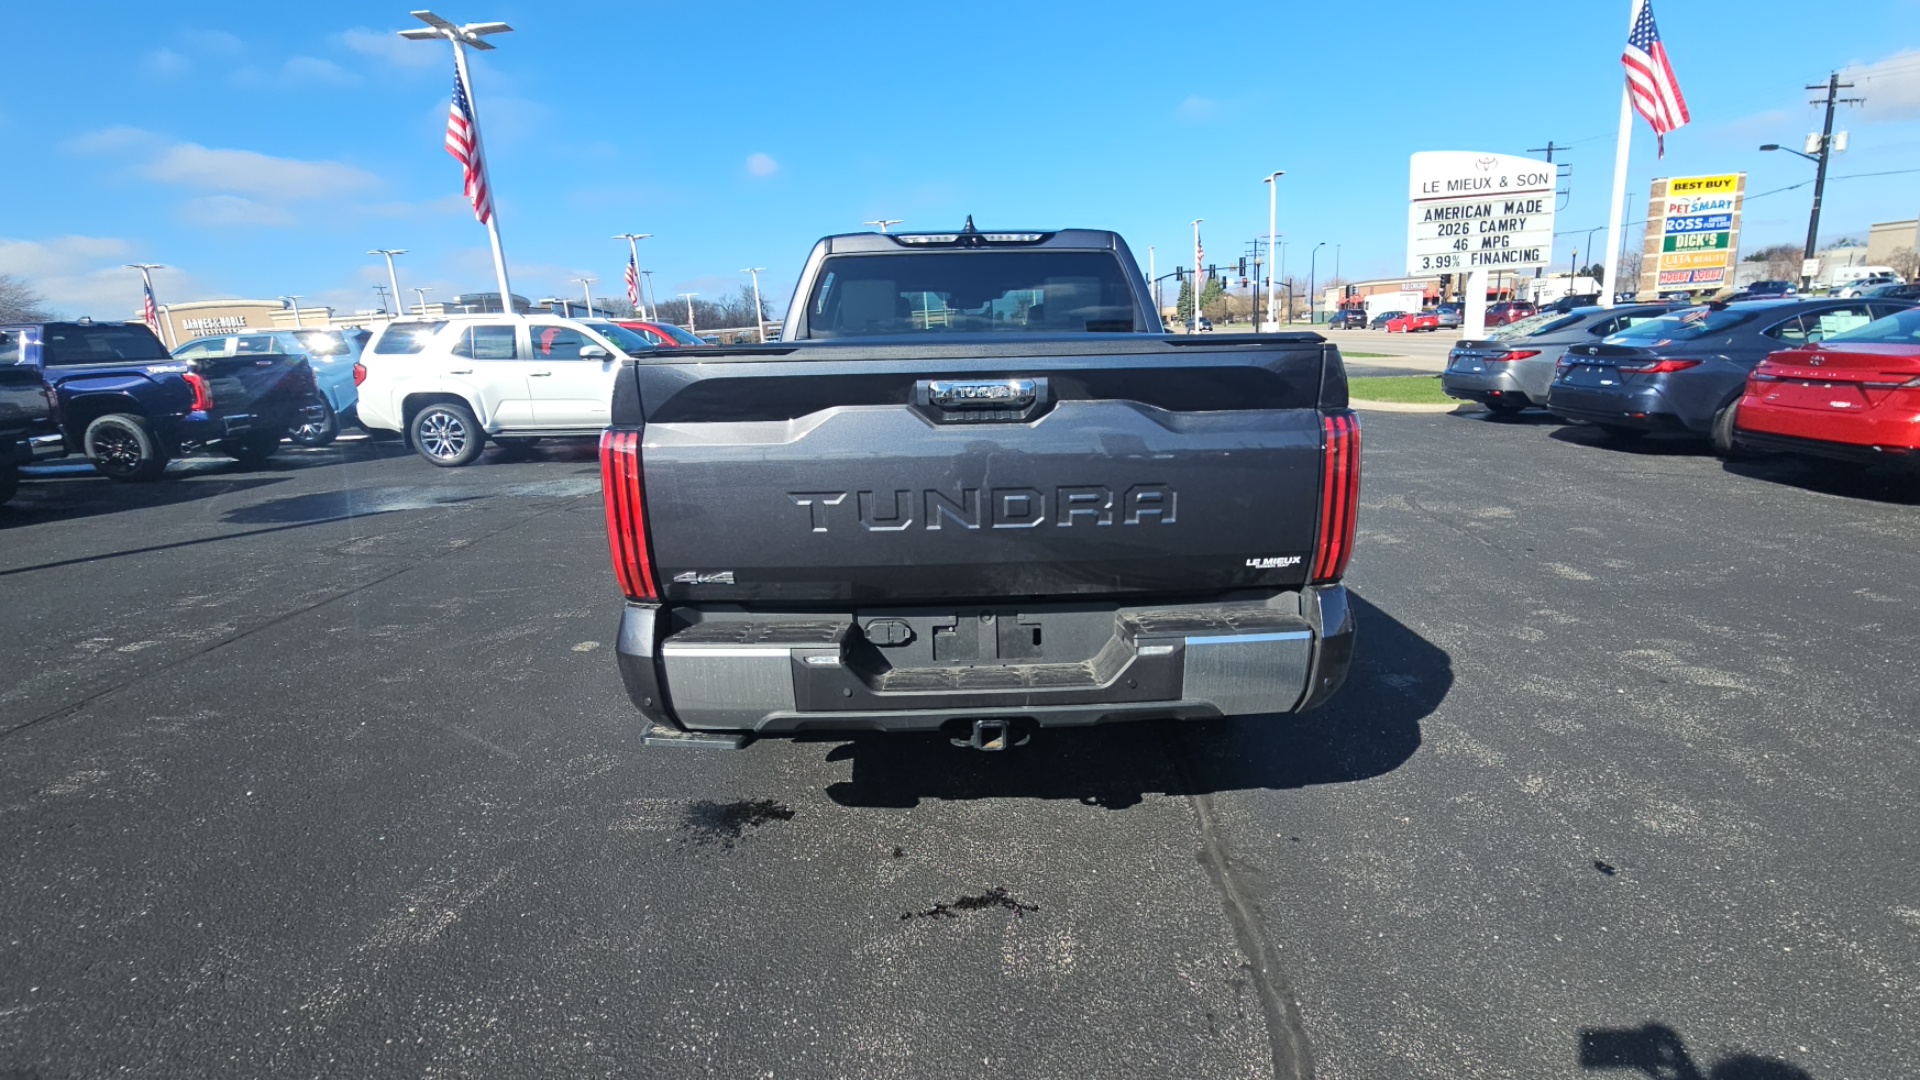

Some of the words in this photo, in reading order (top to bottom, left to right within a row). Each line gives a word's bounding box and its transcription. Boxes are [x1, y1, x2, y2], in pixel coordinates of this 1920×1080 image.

[1423, 181, 1440, 194] LE
[1447, 177, 1492, 191] MIEUX
[1499, 176, 1509, 188] &
[1517, 173, 1549, 186] SON
[1674, 181, 1703, 191] BEST
[1706, 179, 1732, 188] BUY
[1424, 204, 1492, 222] AMERICAN
[1504, 200, 1543, 215] MADE
[1437, 222, 1470, 237] 2026
[1479, 218, 1527, 233] CAMRY
[1666, 217, 1703, 231] ROSS
[1453, 238, 1468, 251] 46
[1481, 235, 1510, 249] MPG
[1676, 233, 1718, 248] DICK'S
[1422, 255, 1460, 269] 3.99%
[1471, 249, 1540, 265] FINANCING
[1665, 254, 1691, 265] ULTA
[1694, 254, 1725, 263] BEAUTY
[1660, 271, 1691, 284] HOBBY
[1694, 269, 1723, 281] LOBBY
[787, 484, 1178, 532] TUNDRA
[1246, 558, 1261, 566] LE
[1262, 556, 1301, 566] MIEUX
